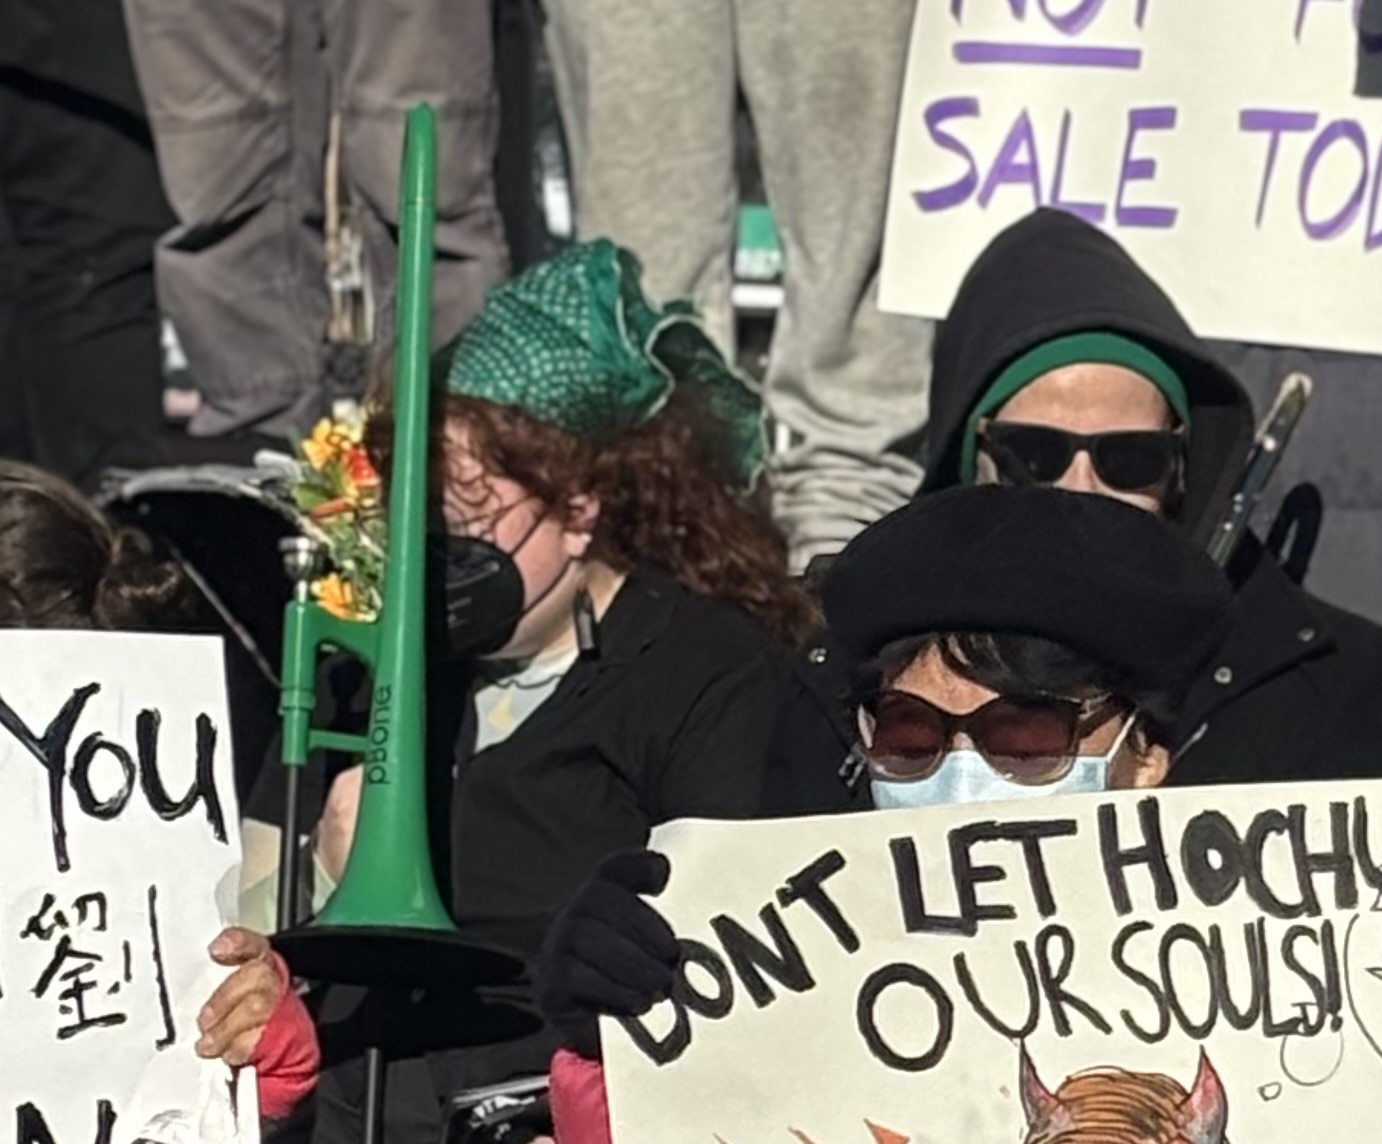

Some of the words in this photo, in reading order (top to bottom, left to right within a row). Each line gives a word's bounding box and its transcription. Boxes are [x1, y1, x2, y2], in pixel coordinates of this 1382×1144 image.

[911, 96, 1178, 229] SALE
[0, 681, 228, 873] YOU
[889, 818, 1078, 938] LET
[856, 923, 1113, 1073] OUR
[1111, 915, 1344, 1045] SOULS!
